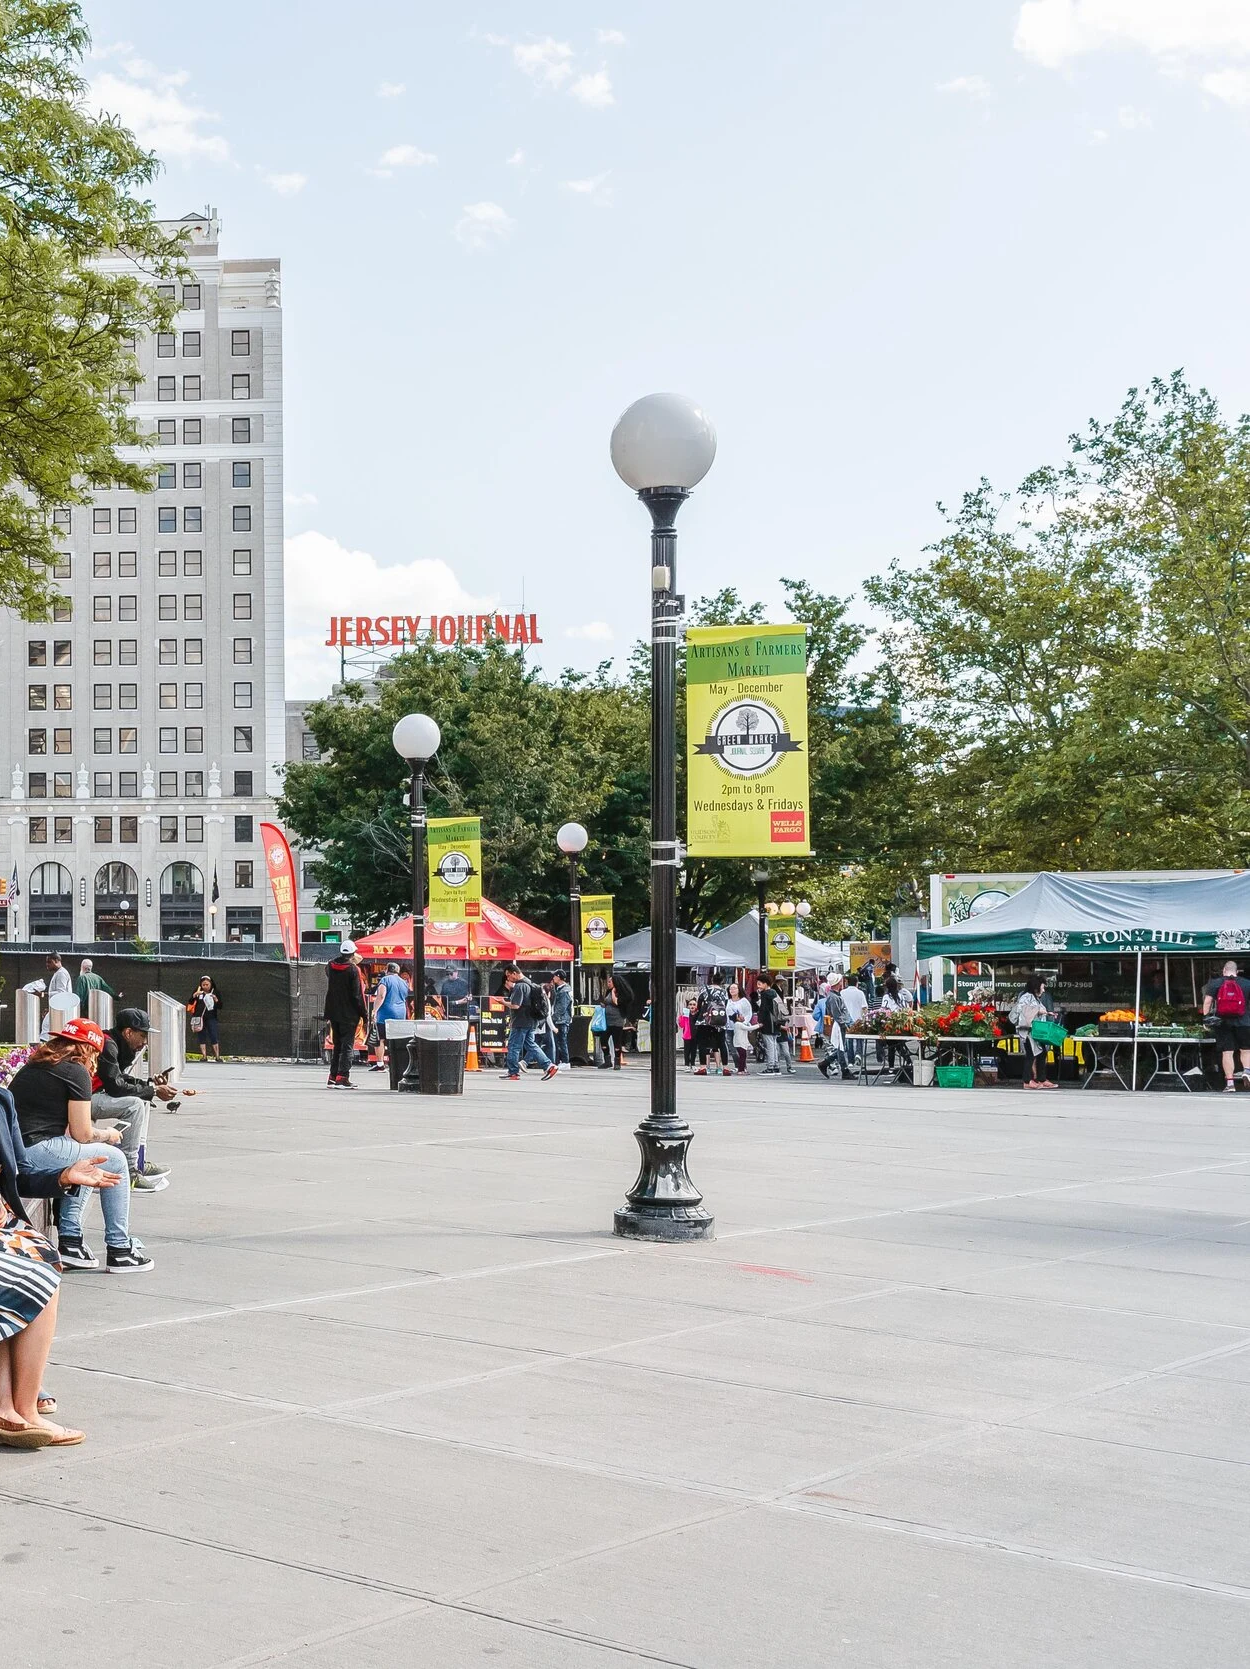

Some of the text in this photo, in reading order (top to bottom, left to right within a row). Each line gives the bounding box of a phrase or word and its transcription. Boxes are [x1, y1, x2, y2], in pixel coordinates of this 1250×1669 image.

[325, 614, 543, 646] JERSEY JOURNAL
[691, 641, 802, 658] ARTISANS & FARMERS
[727, 662, 771, 676] MARKET
[710, 684, 728, 695] May
[737, 682, 783, 694] December
[717, 734, 778, 746] GREEN MARKET
[721, 783, 775, 796] 2pm to 8pm
[694, 798, 803, 812] Wednesdays & Fridays
[1081, 930, 1145, 946] STONY
[373, 945, 499, 957] MY YMMY BQ
